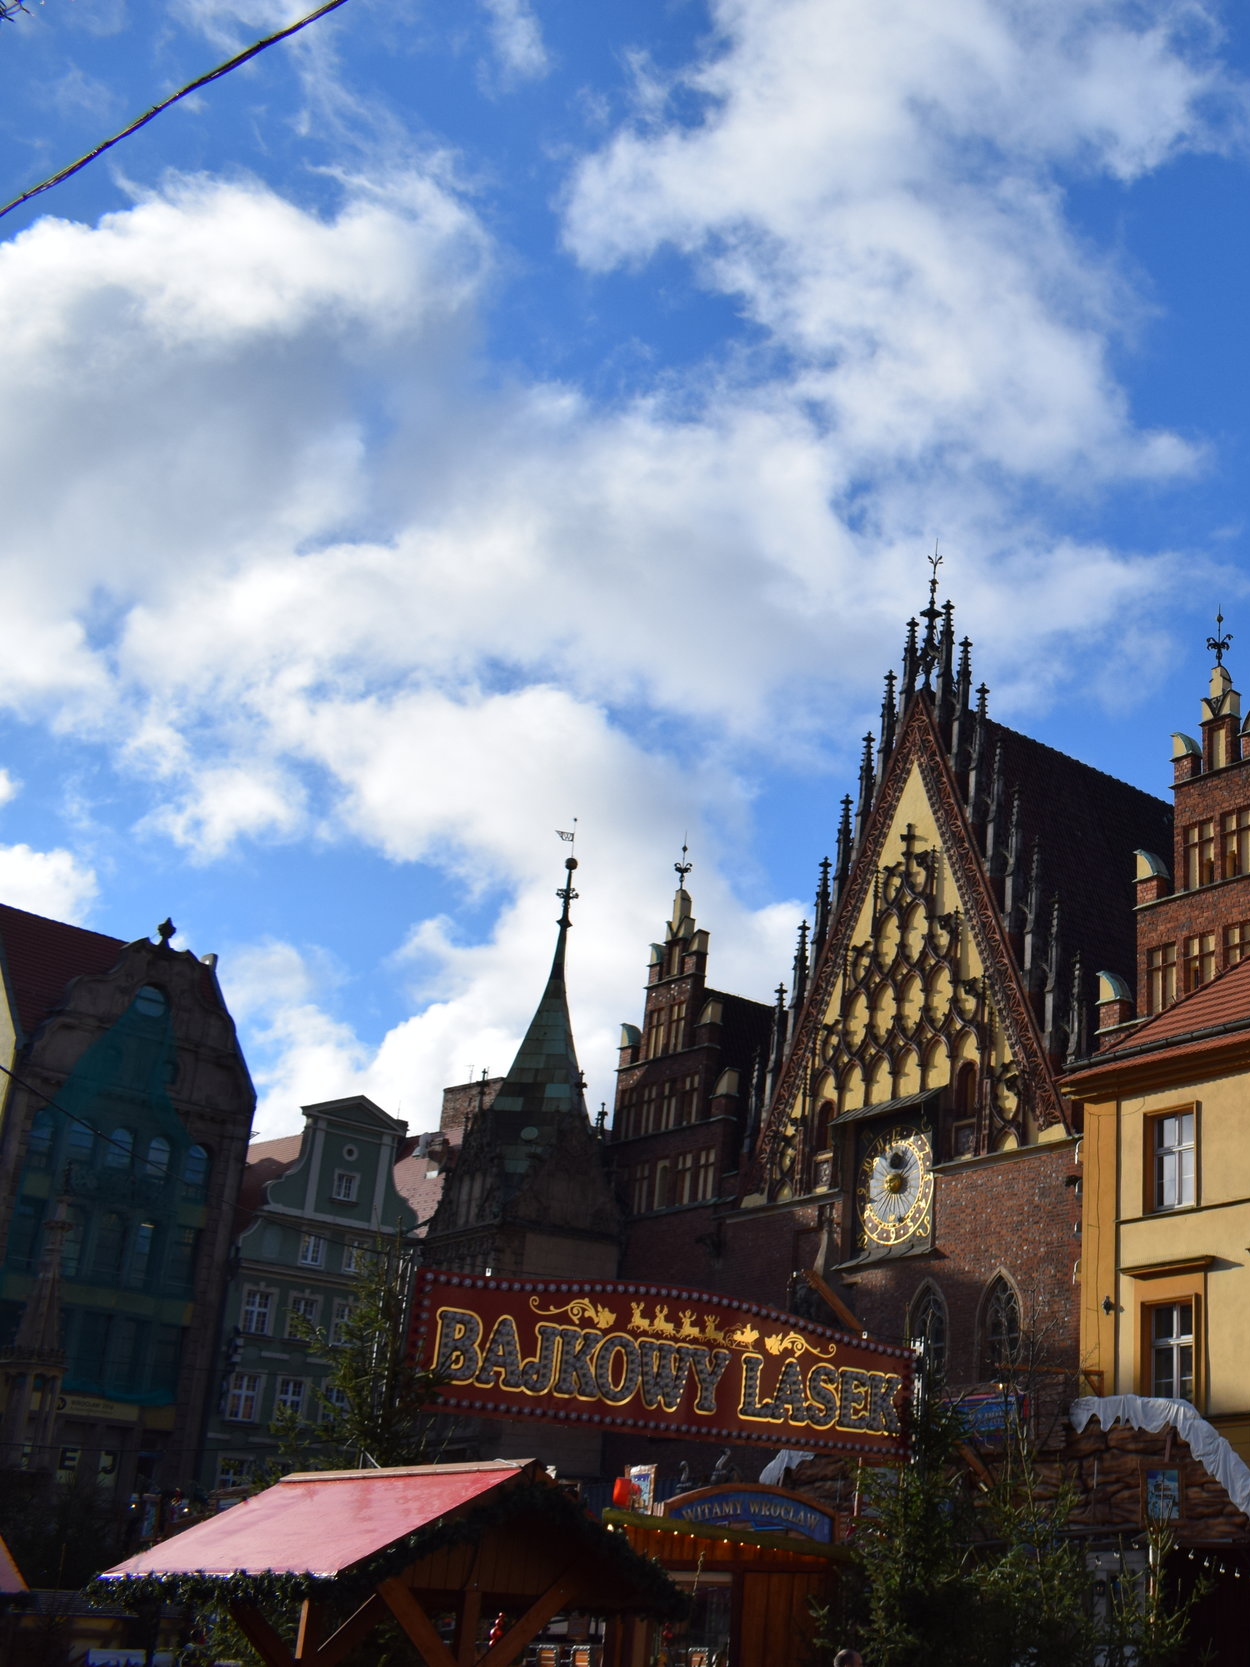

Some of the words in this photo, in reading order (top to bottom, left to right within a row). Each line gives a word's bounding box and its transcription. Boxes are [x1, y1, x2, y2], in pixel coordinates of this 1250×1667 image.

[432, 1306, 730, 1415] BAJKOWY
[738, 1352, 903, 1438] LASEK
[682, 1502, 742, 1522] WITAMY
